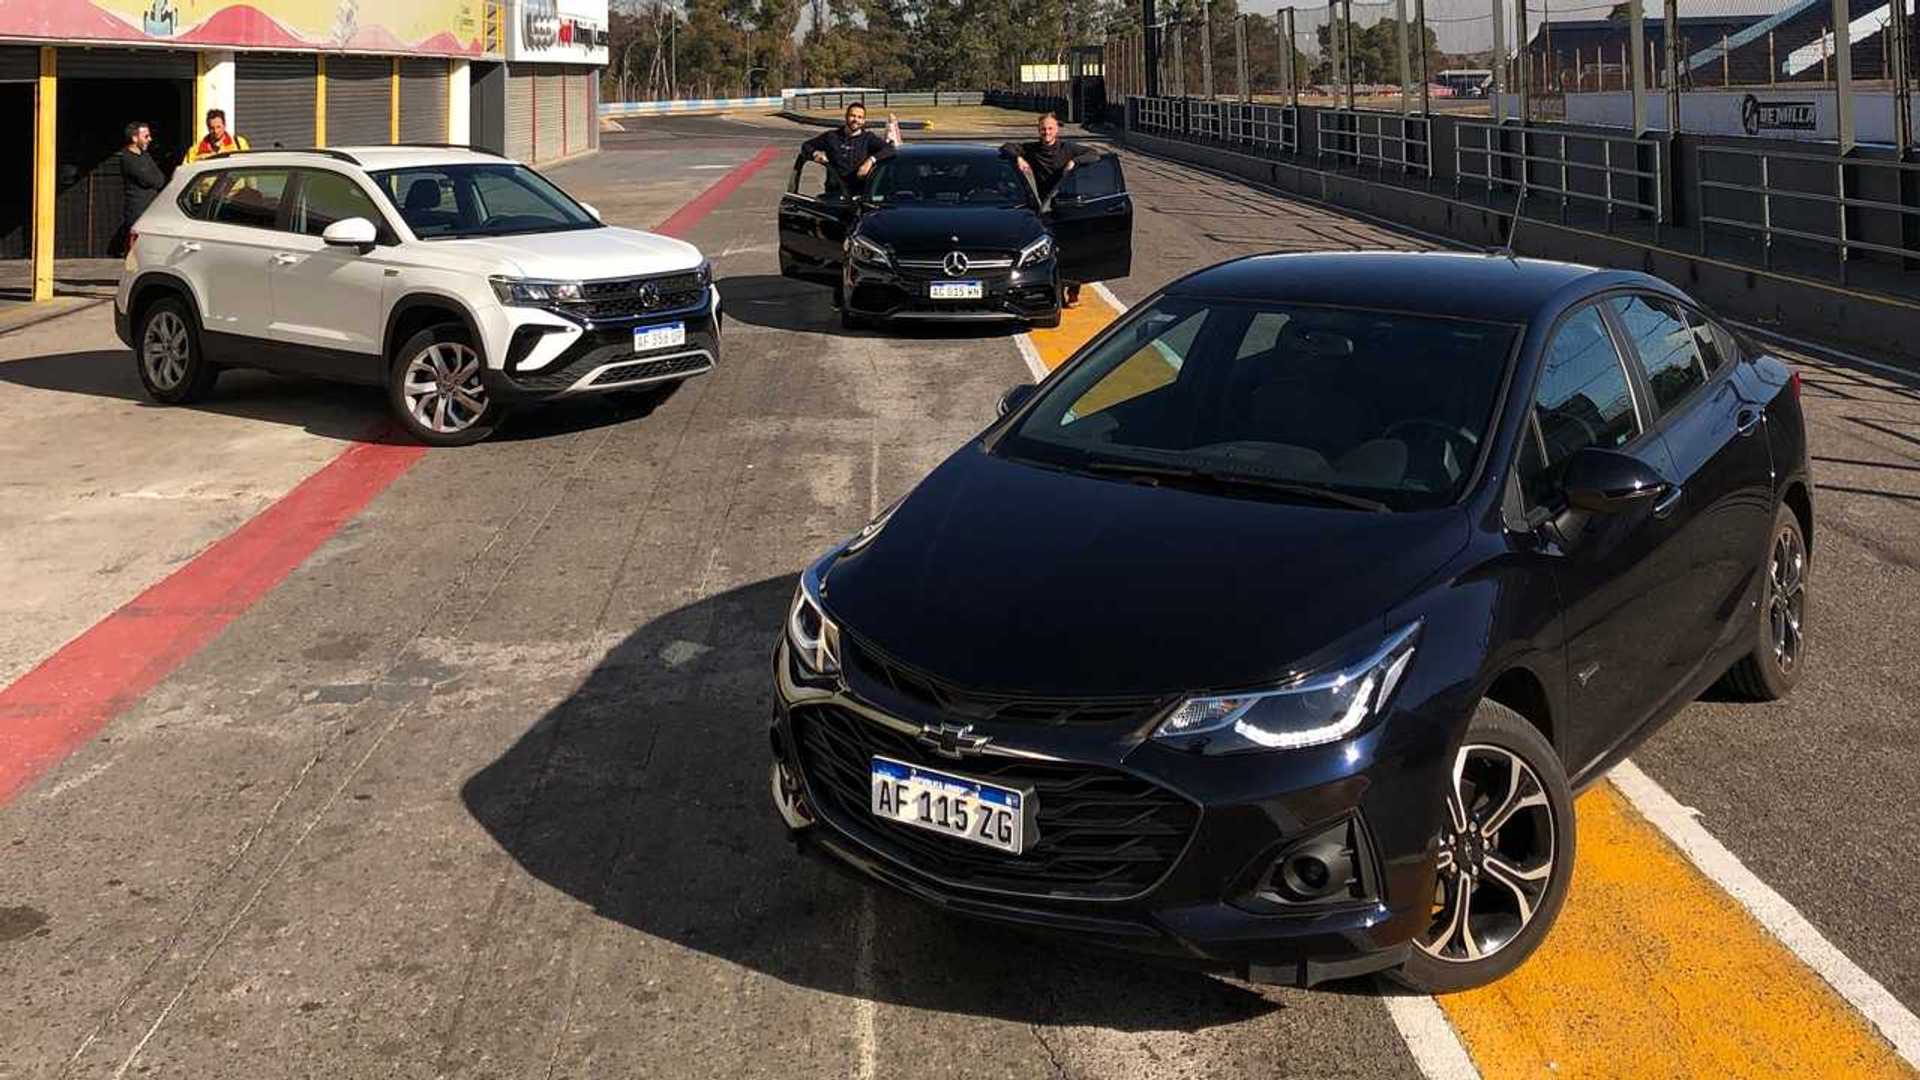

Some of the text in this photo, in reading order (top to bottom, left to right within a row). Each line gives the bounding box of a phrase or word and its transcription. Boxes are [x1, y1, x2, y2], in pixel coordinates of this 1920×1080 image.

[1776, 107, 1815, 123] MILLA
[879, 779, 1012, 845] AF 115 ZG
